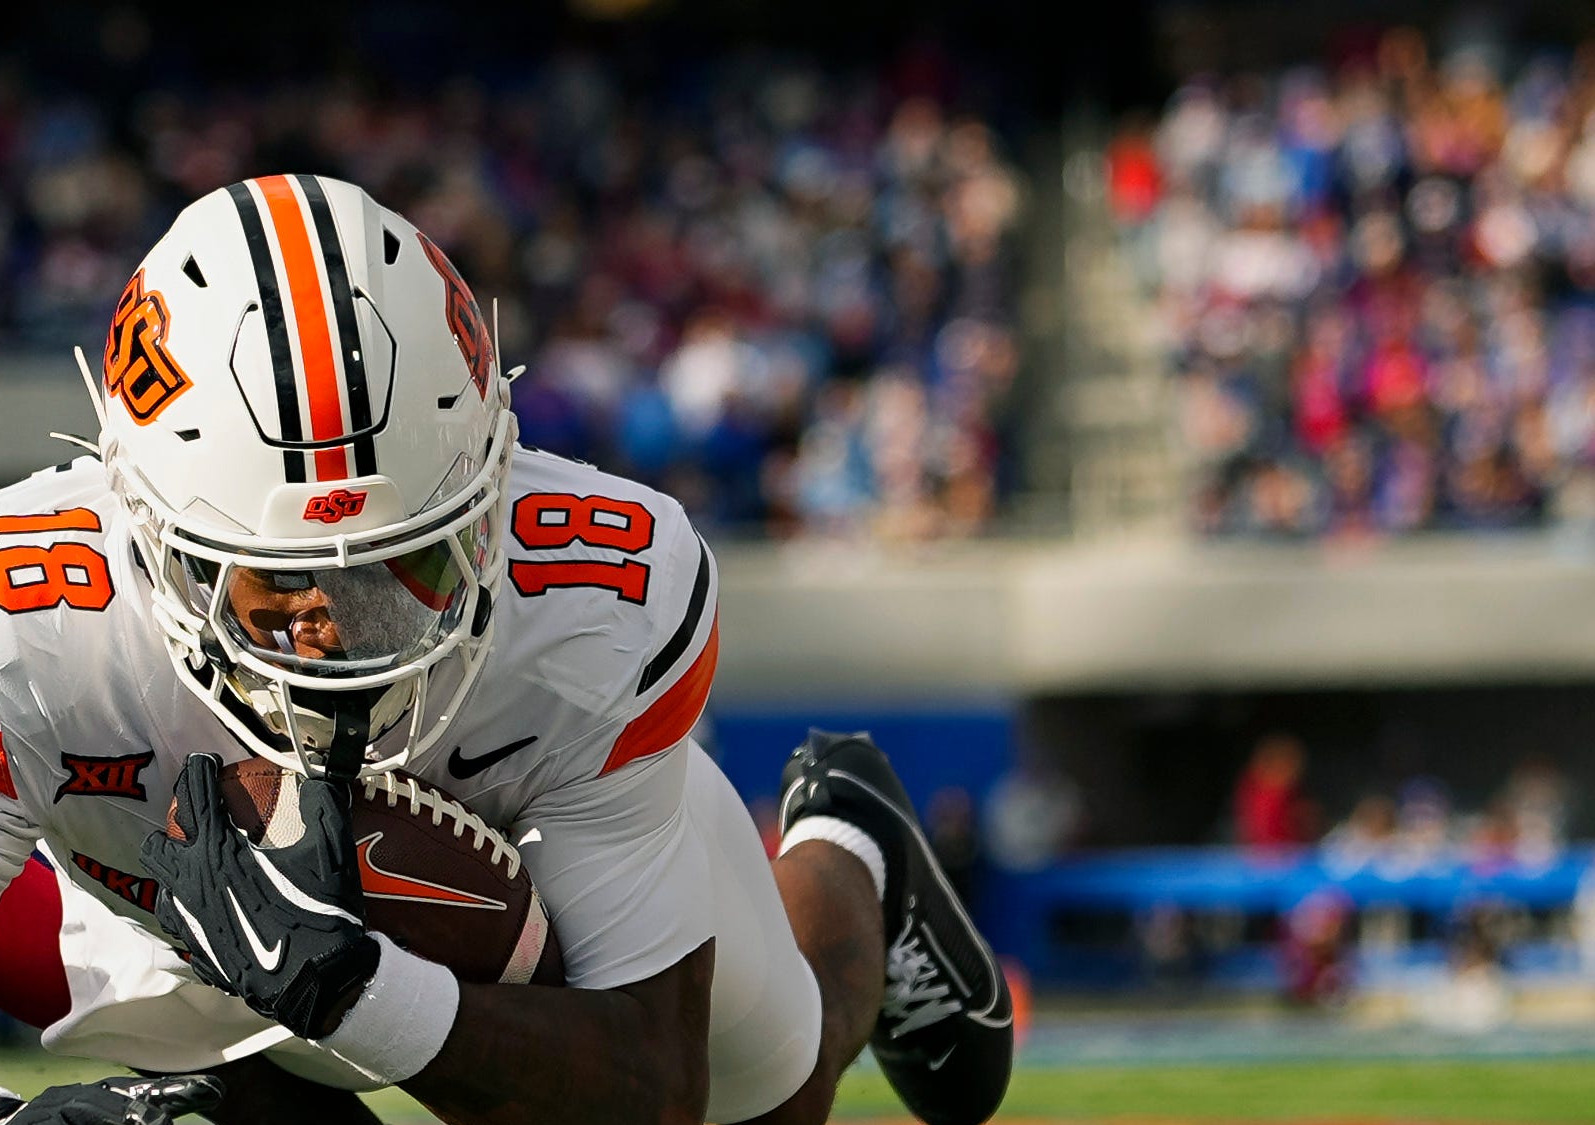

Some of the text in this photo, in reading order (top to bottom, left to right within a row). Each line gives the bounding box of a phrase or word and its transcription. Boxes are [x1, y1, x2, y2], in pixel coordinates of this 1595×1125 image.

[303, 489, 368, 524] OSU
[509, 491, 656, 605] 18
[55, 750, 154, 803] XII
